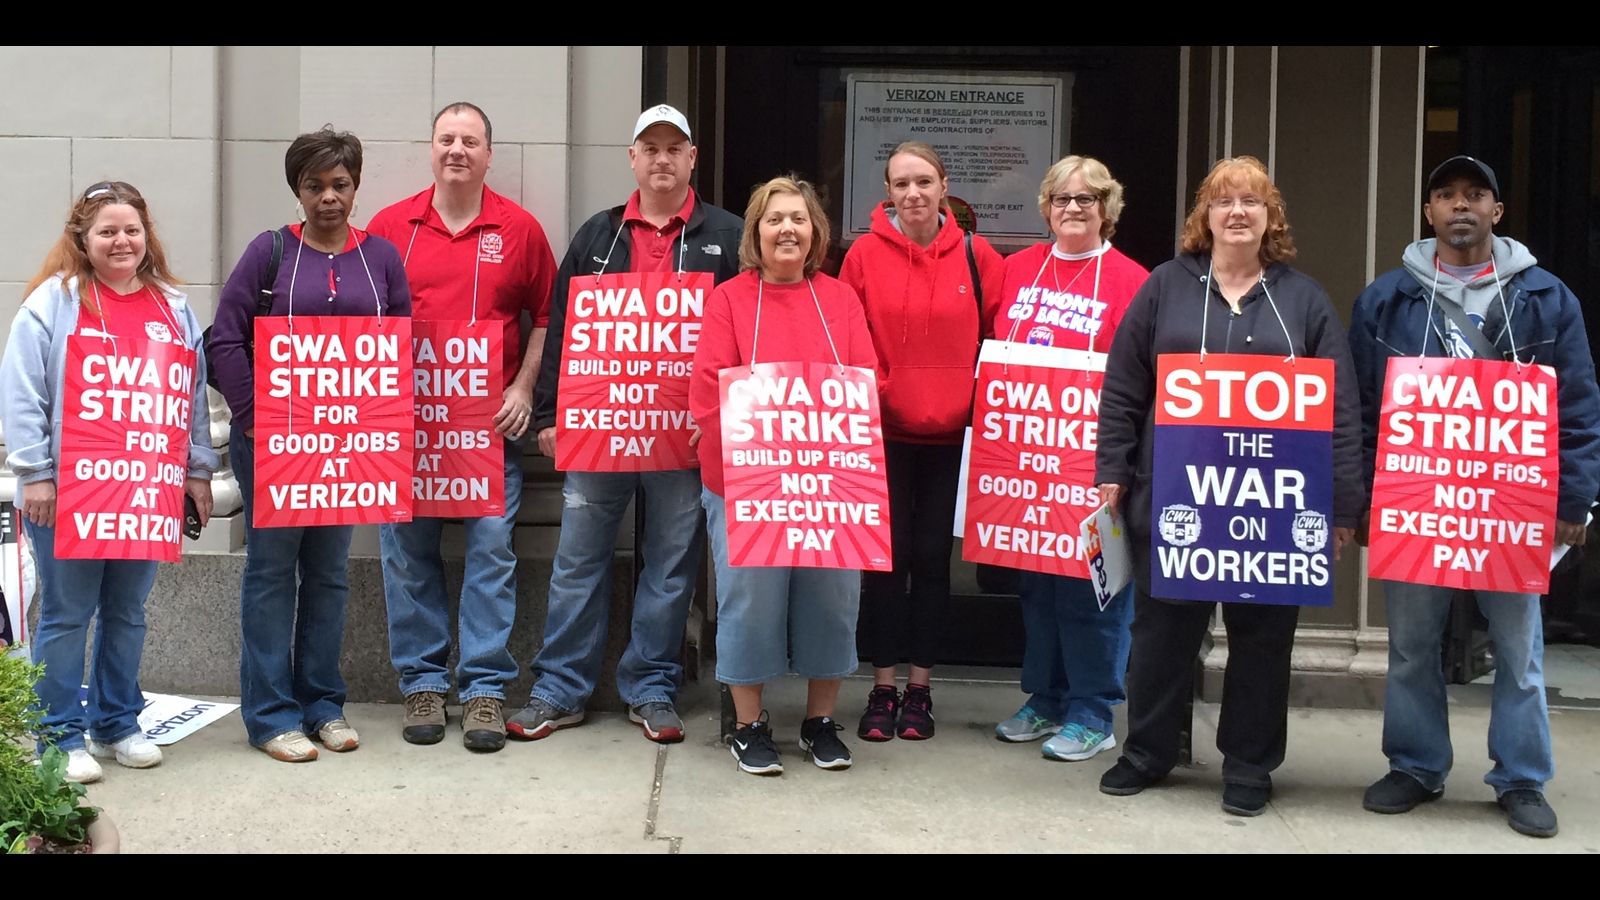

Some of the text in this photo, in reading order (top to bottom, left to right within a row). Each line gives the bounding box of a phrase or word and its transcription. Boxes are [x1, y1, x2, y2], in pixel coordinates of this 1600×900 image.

[886, 89, 1024, 103] VERIZON ENTRANCE
[991, 109, 1033, 117] DELIVERIES
[927, 126, 983, 134] CONTRACTORS
[574, 288, 704, 317] CWA ON
[1016, 287, 1041, 304] WE
[1008, 303, 1034, 320] GO
[270, 335, 346, 362] CWA
[355, 334, 398, 362] ON
[569, 321, 702, 352] STRIKE
[1031, 331, 1051, 341] CWA
[445, 337, 488, 364] ON
[82, 354, 192, 395] CWA ON
[568, 359, 621, 376] BUILD
[626, 360, 652, 376] UP
[269, 367, 399, 398] STRIKE
[413, 368, 489, 397] RIKE
[609, 383, 659, 404] NOT
[729, 377, 870, 410] CWA ON
[1164, 368, 1327, 422] STOP
[1392, 374, 1548, 416] CWA ON
[79, 388, 188, 430] STRIKE
[986, 379, 1102, 416] CWA ON
[313, 405, 358, 425] FOR
[565, 408, 698, 431] EXECUTIVE
[729, 410, 872, 445] STRIKE
[125, 430, 168, 454] FOR
[269, 433, 335, 455] GOOD
[340, 432, 400, 453] JOBS
[433, 430, 491, 450] JOBS
[982, 412, 1098, 450] STRIKE
[1387, 411, 1547, 457] STRIKE
[610, 436, 655, 457] PAY
[1223, 432, 1273, 458] THE
[75, 458, 184, 488] GOOD JOBS
[320, 458, 349, 478] AT
[416, 453, 442, 472] AT
[732, 449, 877, 472] BUILD UP FiOS,
[1018, 452, 1061, 475] FOR
[1385, 453, 1548, 488] BUILD UP FiOS,
[269, 481, 397, 510] VERIZON
[412, 476, 489, 500] RIZON
[780, 473, 833, 495] NOT
[978, 474, 1100, 508] GOOD JOBS
[1185, 464, 1306, 510] WAR
[130, 488, 159, 508] AT
[1434, 484, 1495, 512] NOT
[735, 500, 880, 526] EXECUTIVE
[1022, 505, 1050, 526] AT
[1165, 510, 1196, 523] CWA
[1297, 516, 1323, 530] CWA
[73, 512, 180, 544] VERIZON
[787, 528, 835, 551] PAY
[1229, 516, 1266, 541] ON
[1380, 508, 1544, 547] EXECUTIVE
[1087, 517, 1111, 608] FedEx
[1157, 546, 1329, 586] WORKERS
[1433, 545, 1490, 572] PAY
